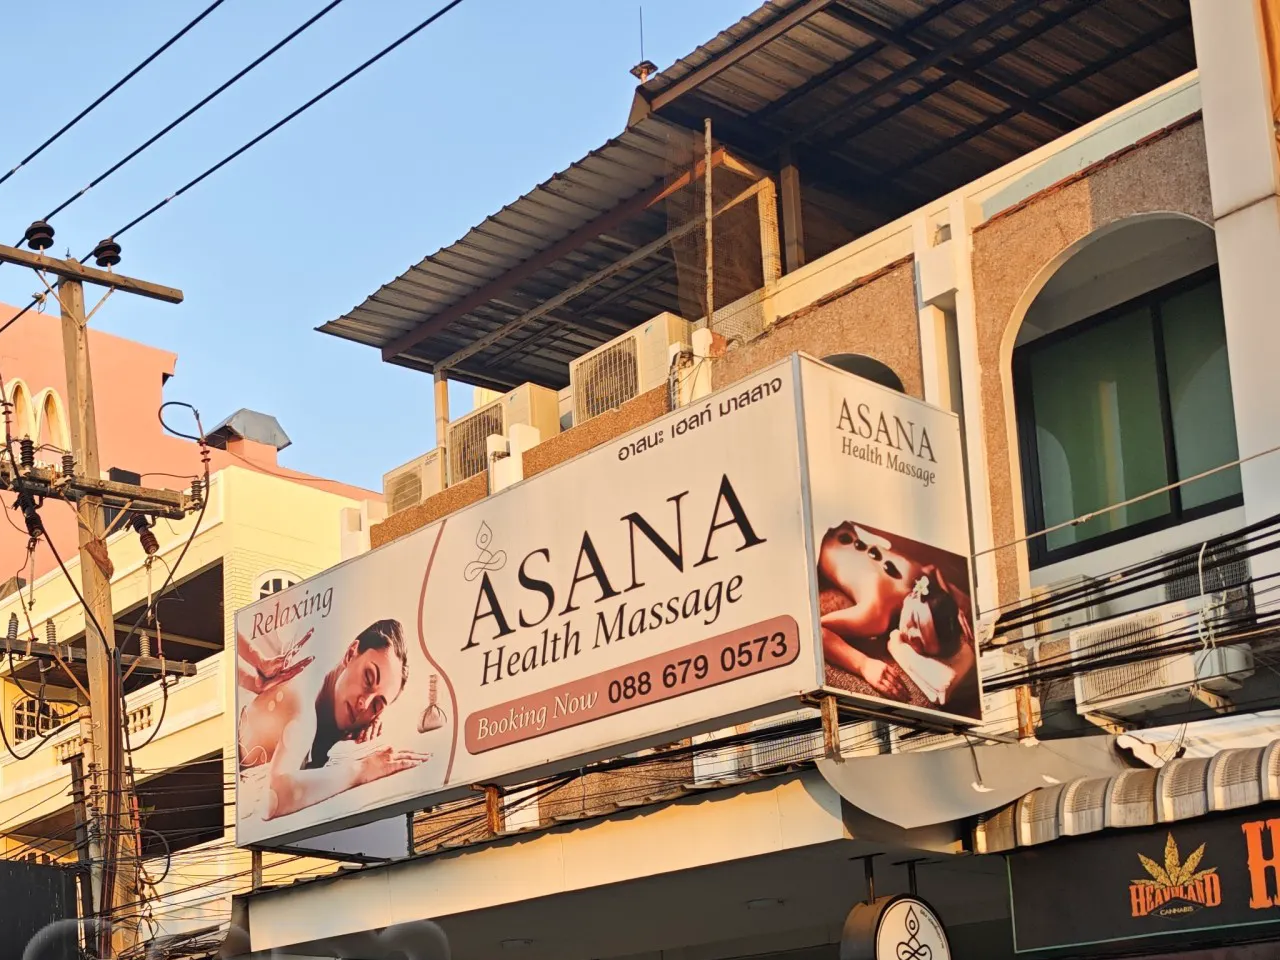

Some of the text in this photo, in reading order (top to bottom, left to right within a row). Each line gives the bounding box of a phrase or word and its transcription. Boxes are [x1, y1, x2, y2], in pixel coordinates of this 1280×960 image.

[618, 430, 664, 461] อาสนะ
[719, 377, 783, 417] มาสสาจ
[836, 397, 938, 464] ASANA
[841, 436, 936, 487] Health Massage
[460, 473, 767, 652] ASANA
[251, 586, 334, 640] Relaxing
[480, 573, 744, 687] Health Massage
[477, 631, 788, 741] Booking Now 088 679 0573
[1159, 906, 1194, 916] CANNABIS
